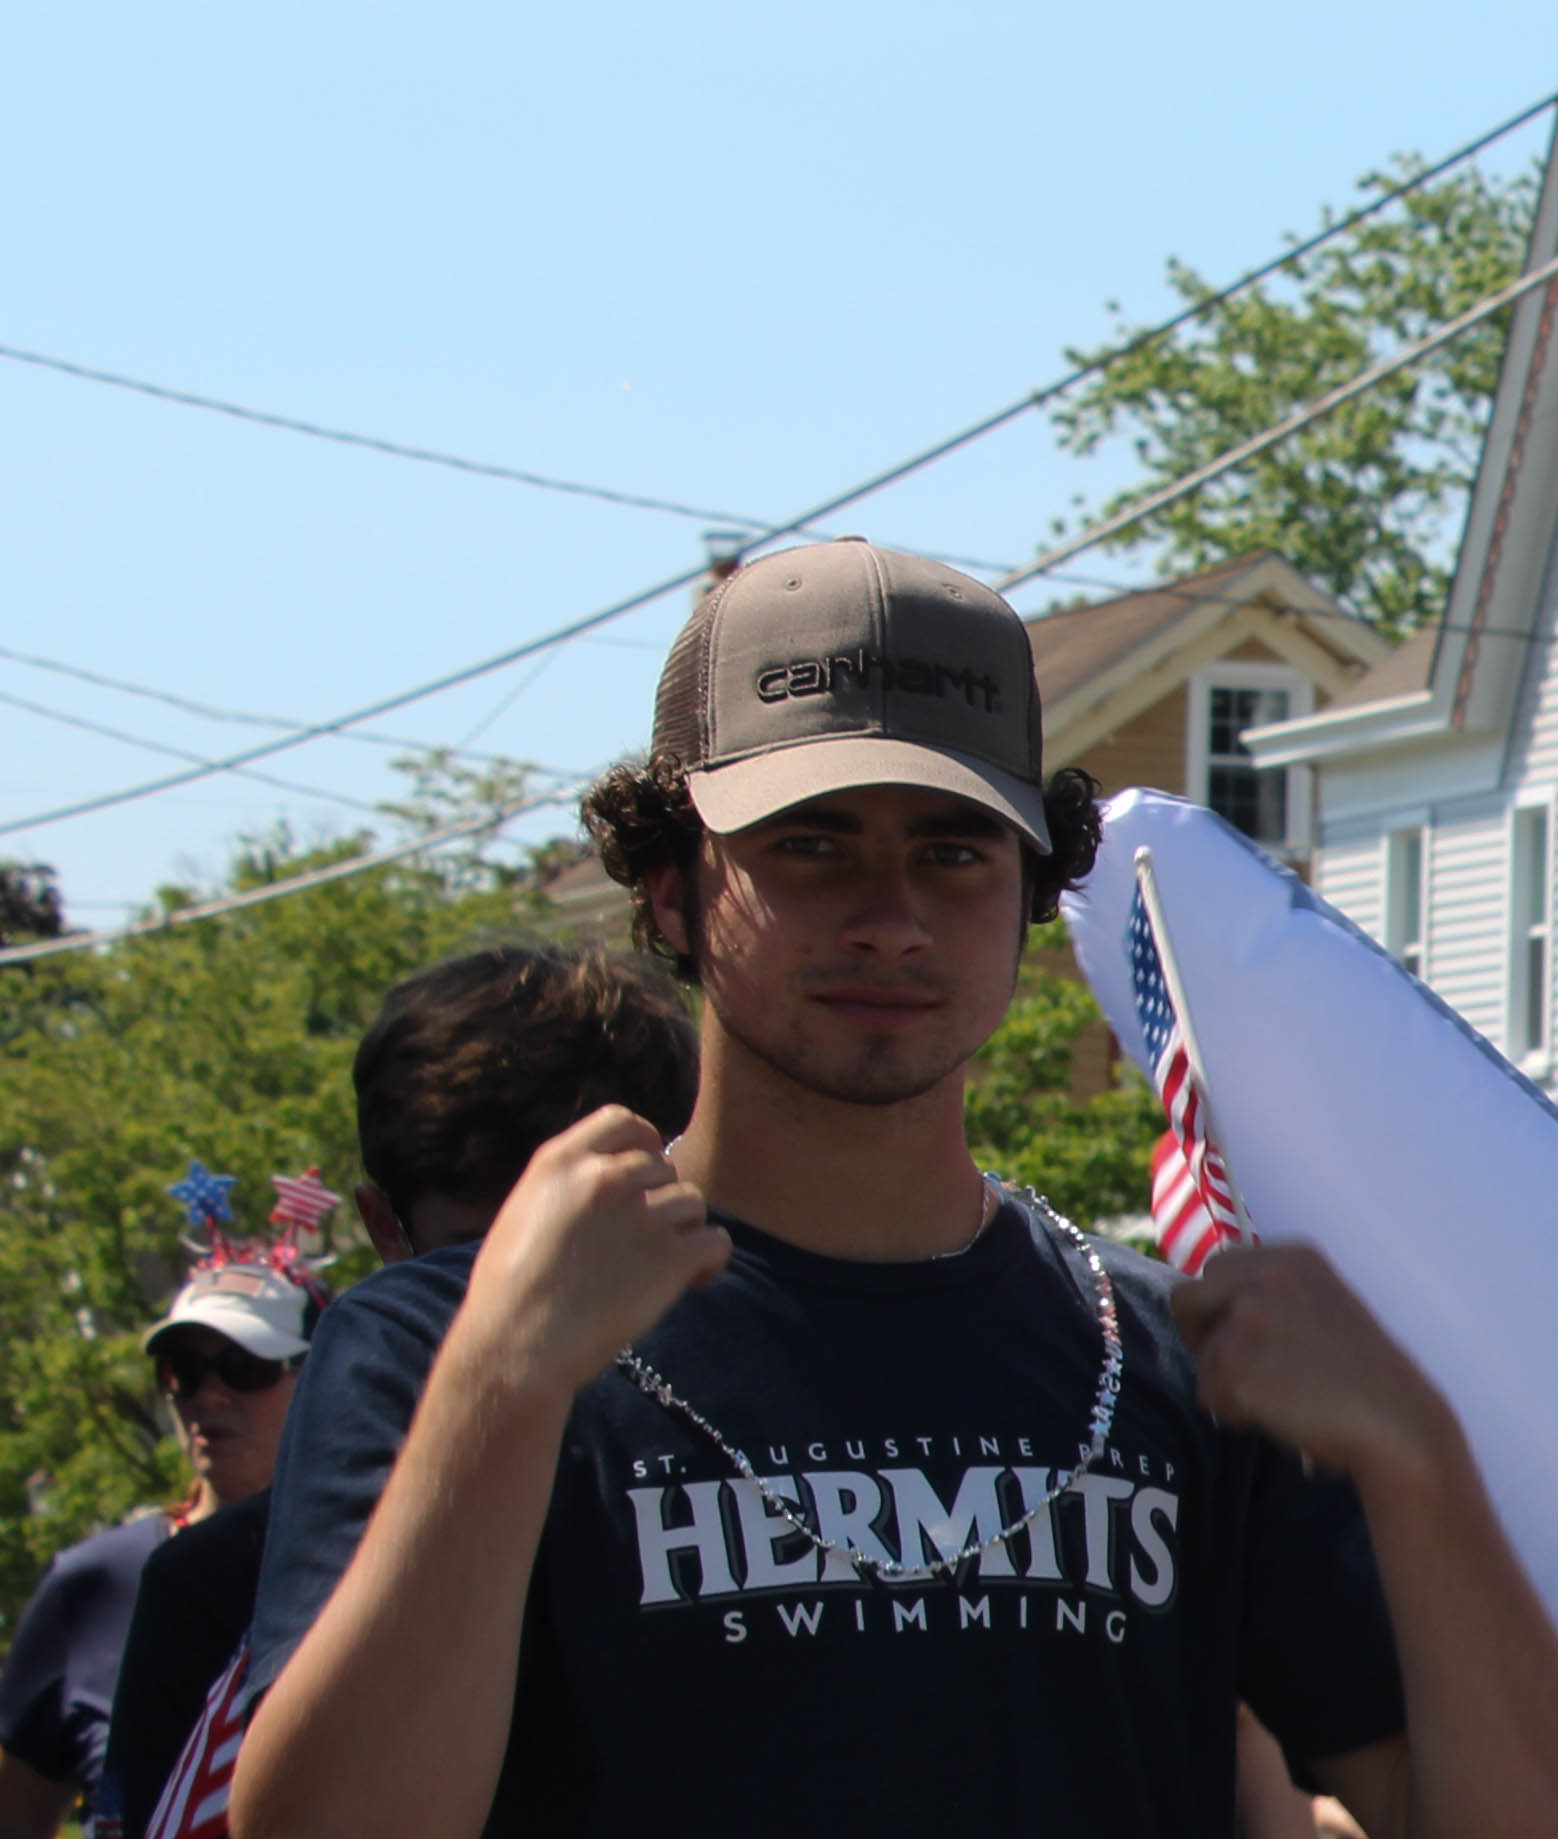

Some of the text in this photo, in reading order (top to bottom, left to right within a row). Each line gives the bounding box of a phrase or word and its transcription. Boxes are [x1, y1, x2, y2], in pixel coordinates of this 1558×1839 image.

[756, 647, 1000, 714] carhartt
[632, 1435, 1176, 1484] ST. UGUSTINE PREP
[625, 1465, 1181, 1608] HERMITS
[723, 1595, 1128, 1643] SWIMMING
